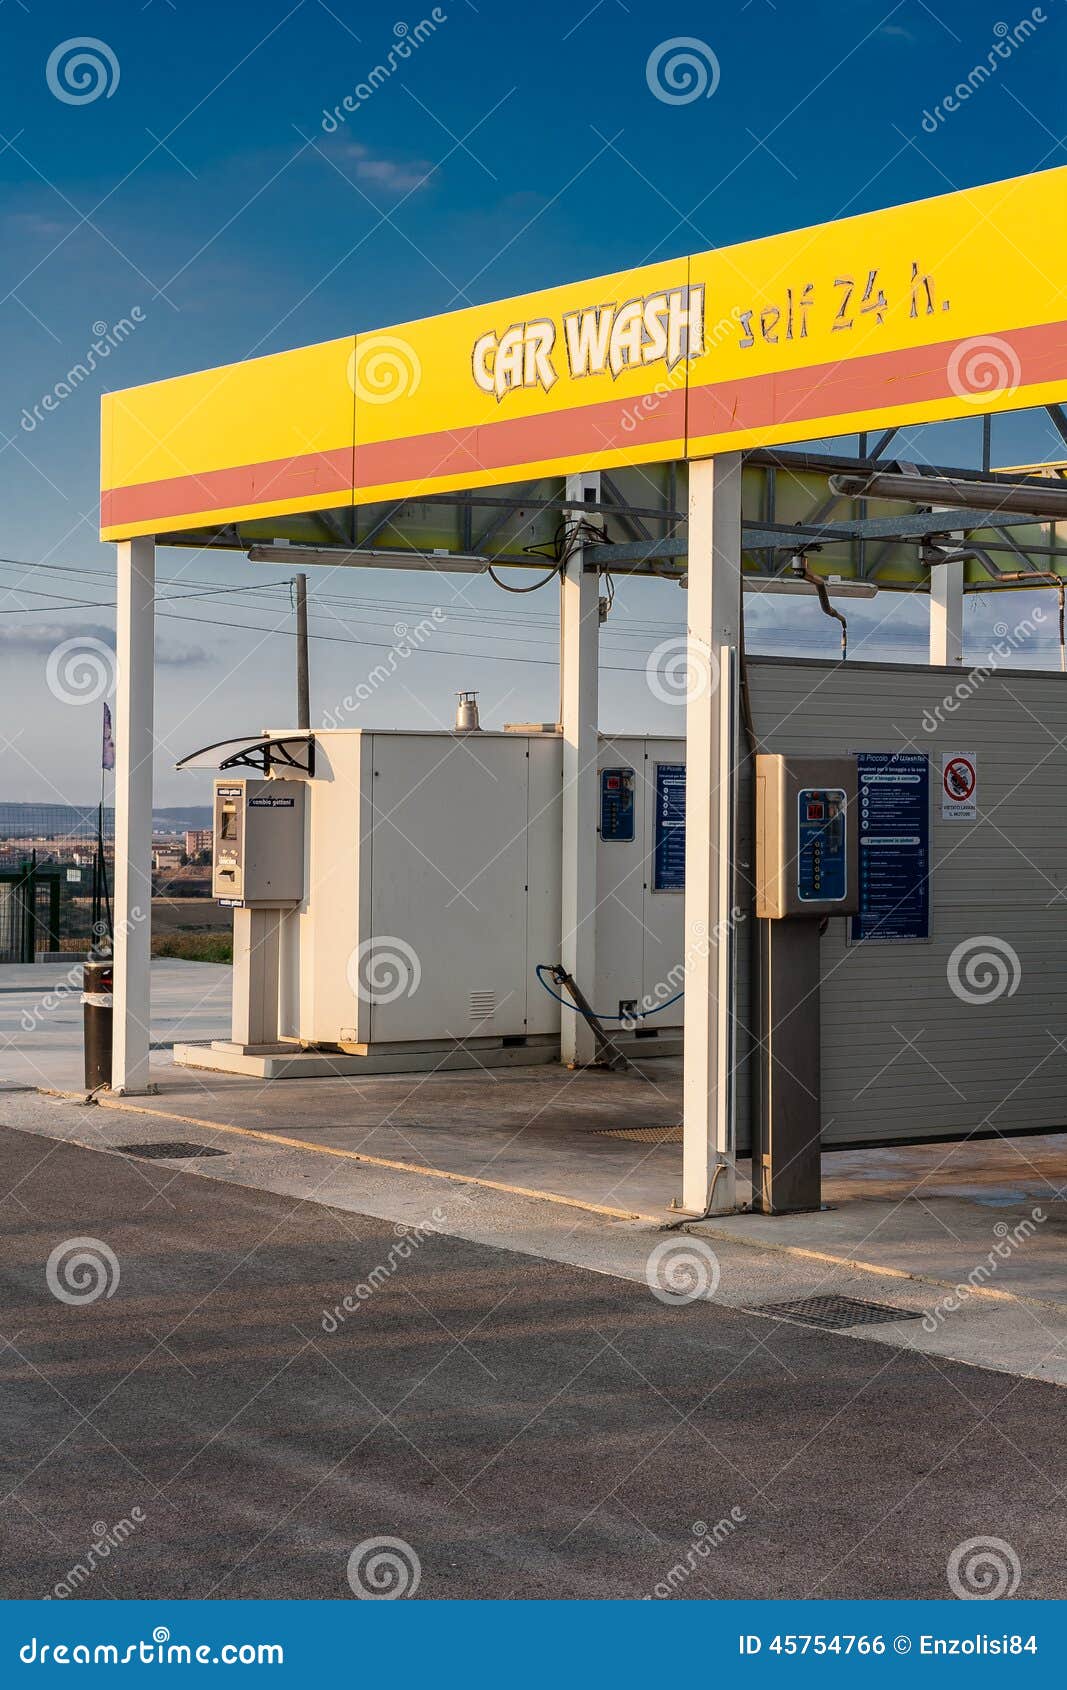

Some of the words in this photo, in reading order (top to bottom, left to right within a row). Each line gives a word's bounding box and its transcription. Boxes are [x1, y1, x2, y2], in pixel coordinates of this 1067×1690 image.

[472, 318, 559, 403] CAR
[562, 283, 706, 381] WASH
[739, 284, 814, 348] self
[831, 270, 888, 331] 24
